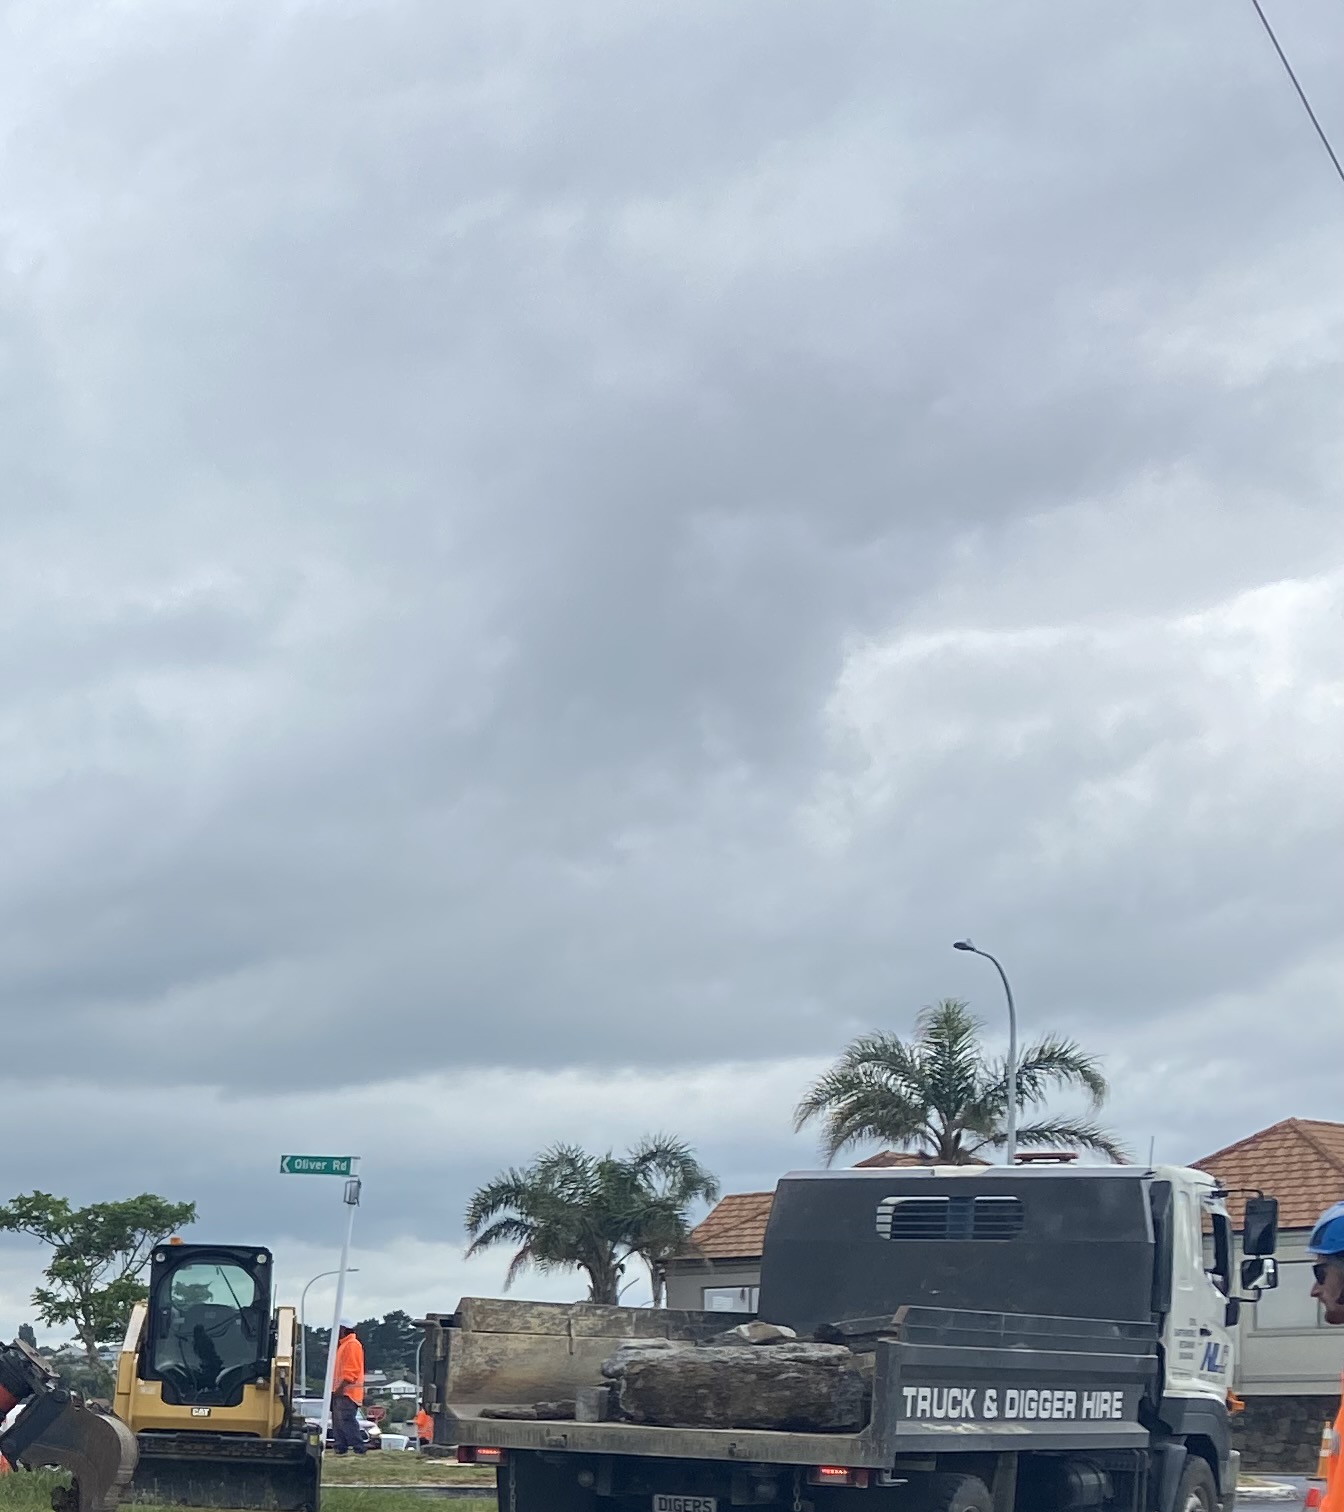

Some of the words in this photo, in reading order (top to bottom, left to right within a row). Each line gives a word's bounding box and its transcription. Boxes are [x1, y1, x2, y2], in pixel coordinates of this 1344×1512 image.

[294, 1158, 327, 1170] Oliver
[333, 1160, 347, 1171] Rd
[902, 1386, 976, 1419] TRUCK
[983, 1388, 998, 1419] &
[1005, 1389, 1077, 1419] DIGGER
[1082, 1391, 1124, 1419] HIRE
[192, 1408, 210, 1417] CAT
